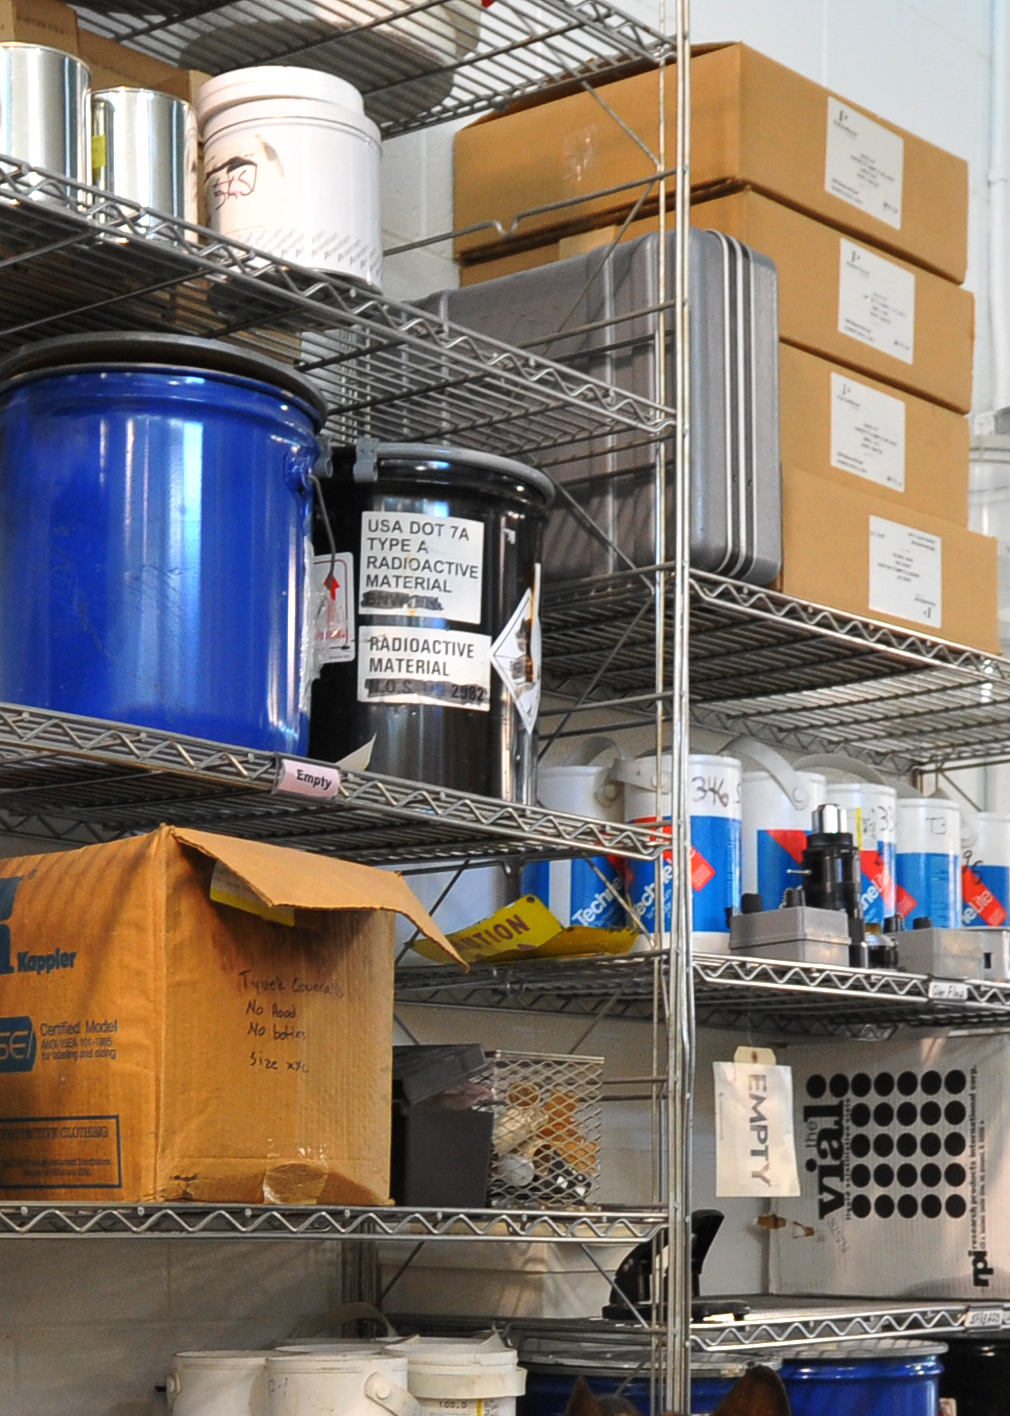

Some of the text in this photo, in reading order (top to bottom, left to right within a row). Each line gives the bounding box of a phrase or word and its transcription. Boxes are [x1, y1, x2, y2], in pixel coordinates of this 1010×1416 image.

[368, 519, 470, 541] USA DOT 7A
[367, 537, 429, 554] TYPE A
[366, 556, 479, 579] RADIOACTIVE
[366, 574, 452, 593] MATERIAL
[369, 636, 474, 658] RADIOACTIVE
[369, 658, 450, 676] MATERIAL
[296, 769, 332, 791] Empty
[17, 948, 77, 975] Kappler
[246, 1000, 264, 1016] No
[85, 1019, 118, 1034] Model
[248, 1022, 266, 1037] No
[748, 1074, 771, 1187] EMPTY
[804, 1120, 818, 1149] the
[969, 1094, 977, 1157] international
[803, 1100, 846, 1220] vial
[969, 1161, 977, 1204] products
[968, 1250, 994, 1287] rpi
